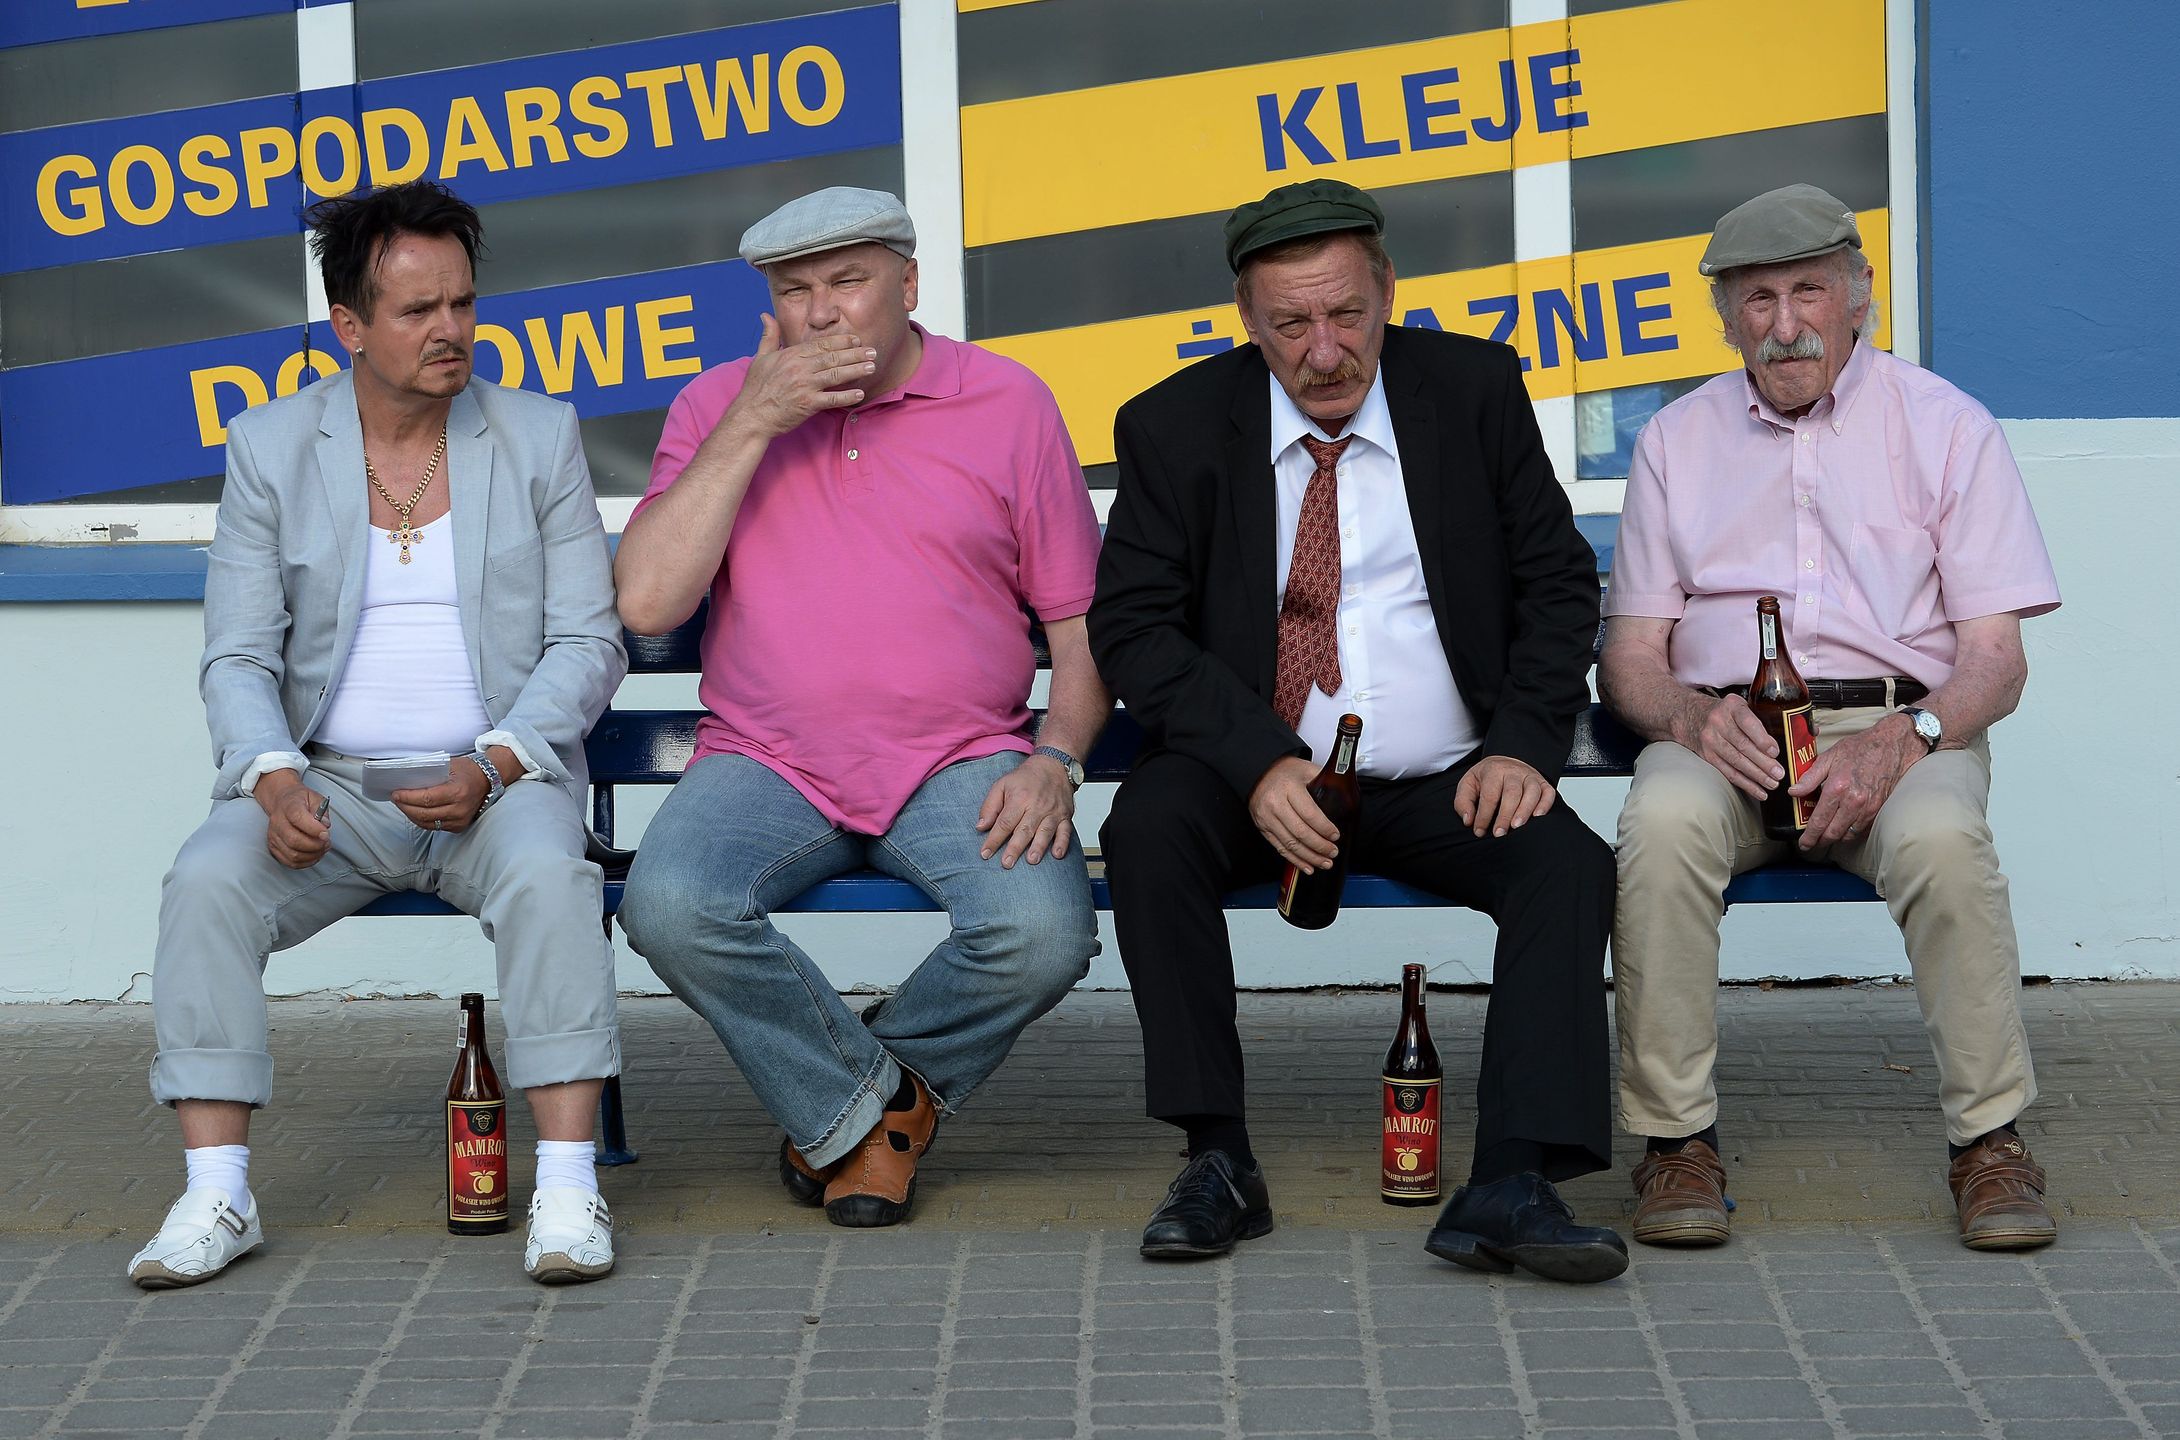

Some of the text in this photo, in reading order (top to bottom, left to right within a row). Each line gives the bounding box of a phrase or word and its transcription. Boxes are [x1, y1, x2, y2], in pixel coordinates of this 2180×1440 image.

[36, 45, 846, 237] GOSPODARSTWO
[1256, 48, 1590, 172] KLEJE
[189, 294, 703, 448] DOWE
[1384, 1116, 1437, 1136] MAMROT
